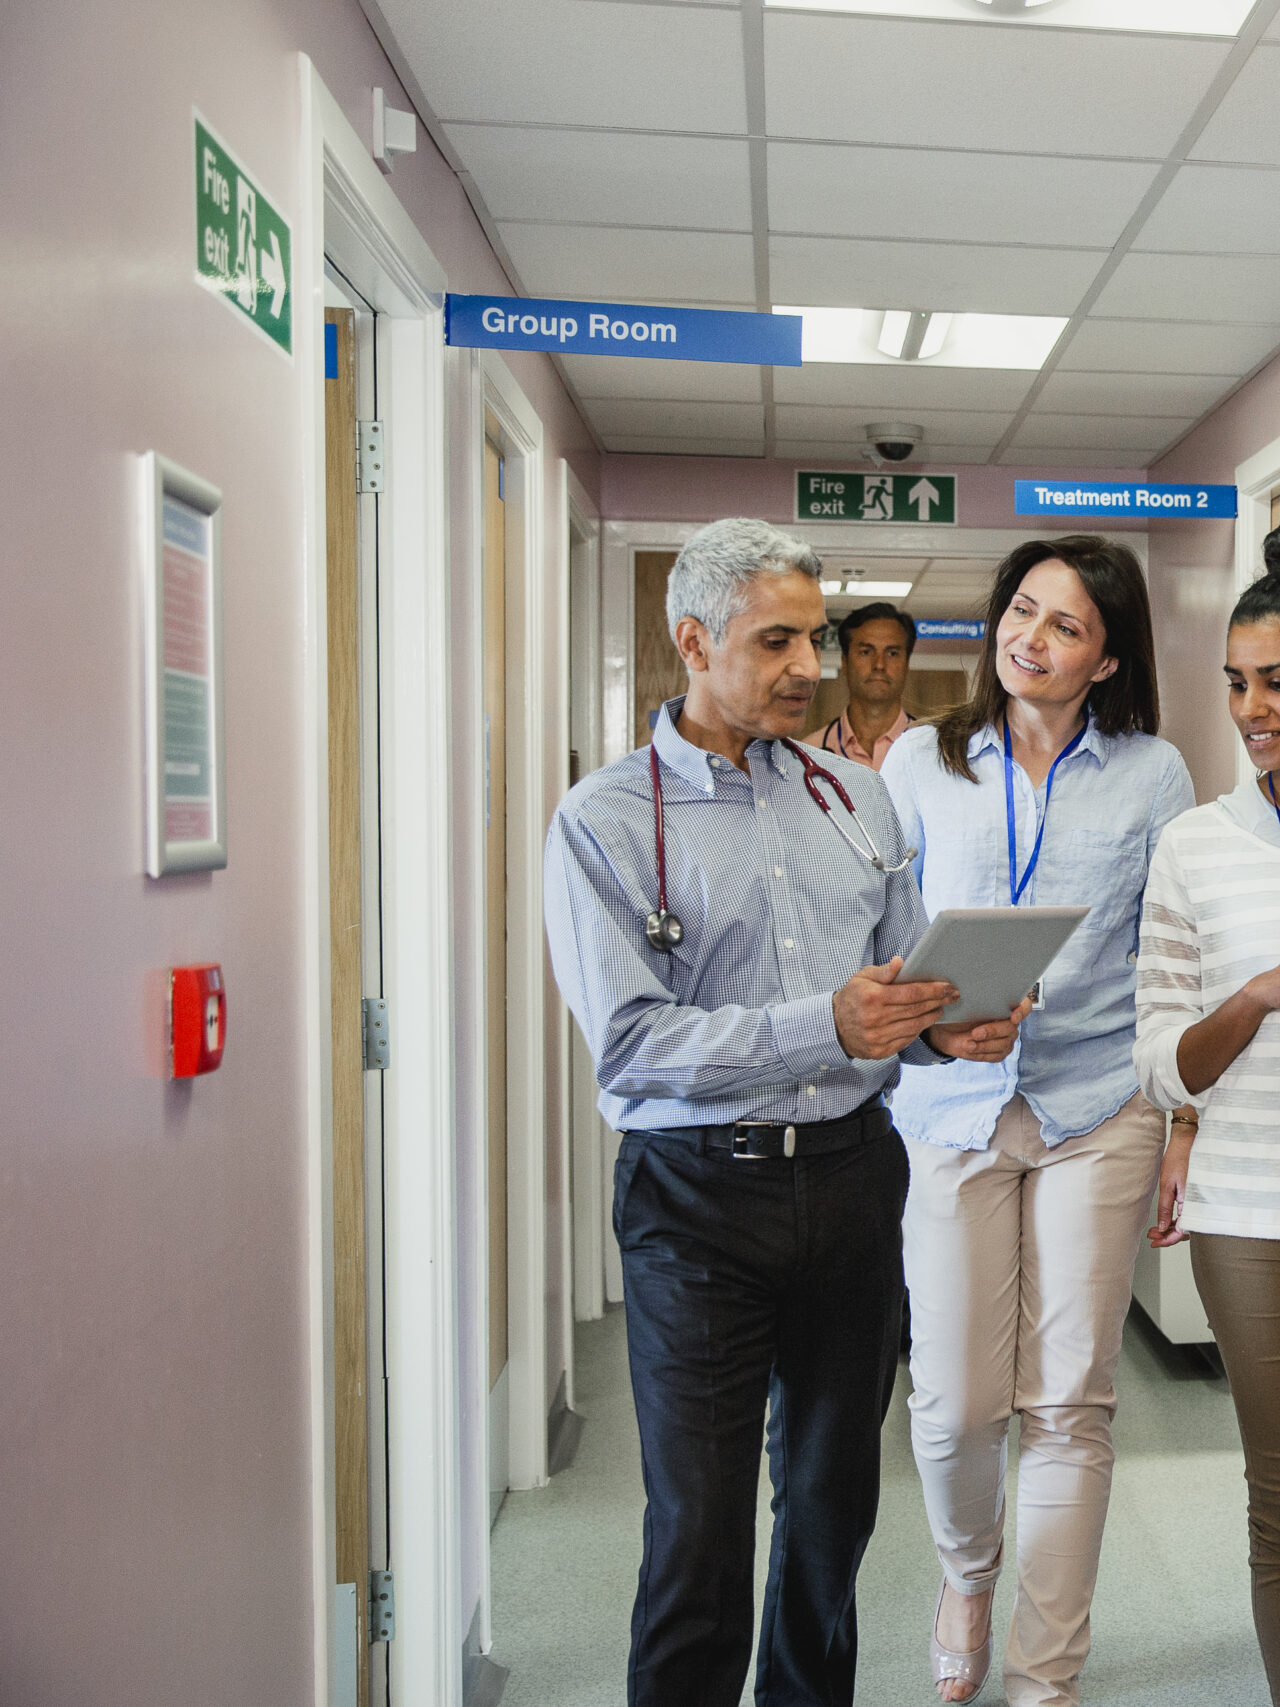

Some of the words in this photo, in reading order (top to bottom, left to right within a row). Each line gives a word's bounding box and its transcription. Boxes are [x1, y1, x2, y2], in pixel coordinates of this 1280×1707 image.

[204, 146, 230, 215] Fire
[204, 226, 230, 277] exit
[481, 307, 578, 343] Group
[589, 313, 677, 343] Room
[810, 478, 845, 494] Fire
[810, 499, 845, 515] exit
[1035, 487, 1130, 506] Treatment
[1136, 490, 1191, 508] Room
[1197, 492, 1208, 508] 2
[917, 622, 978, 637] Consulting
